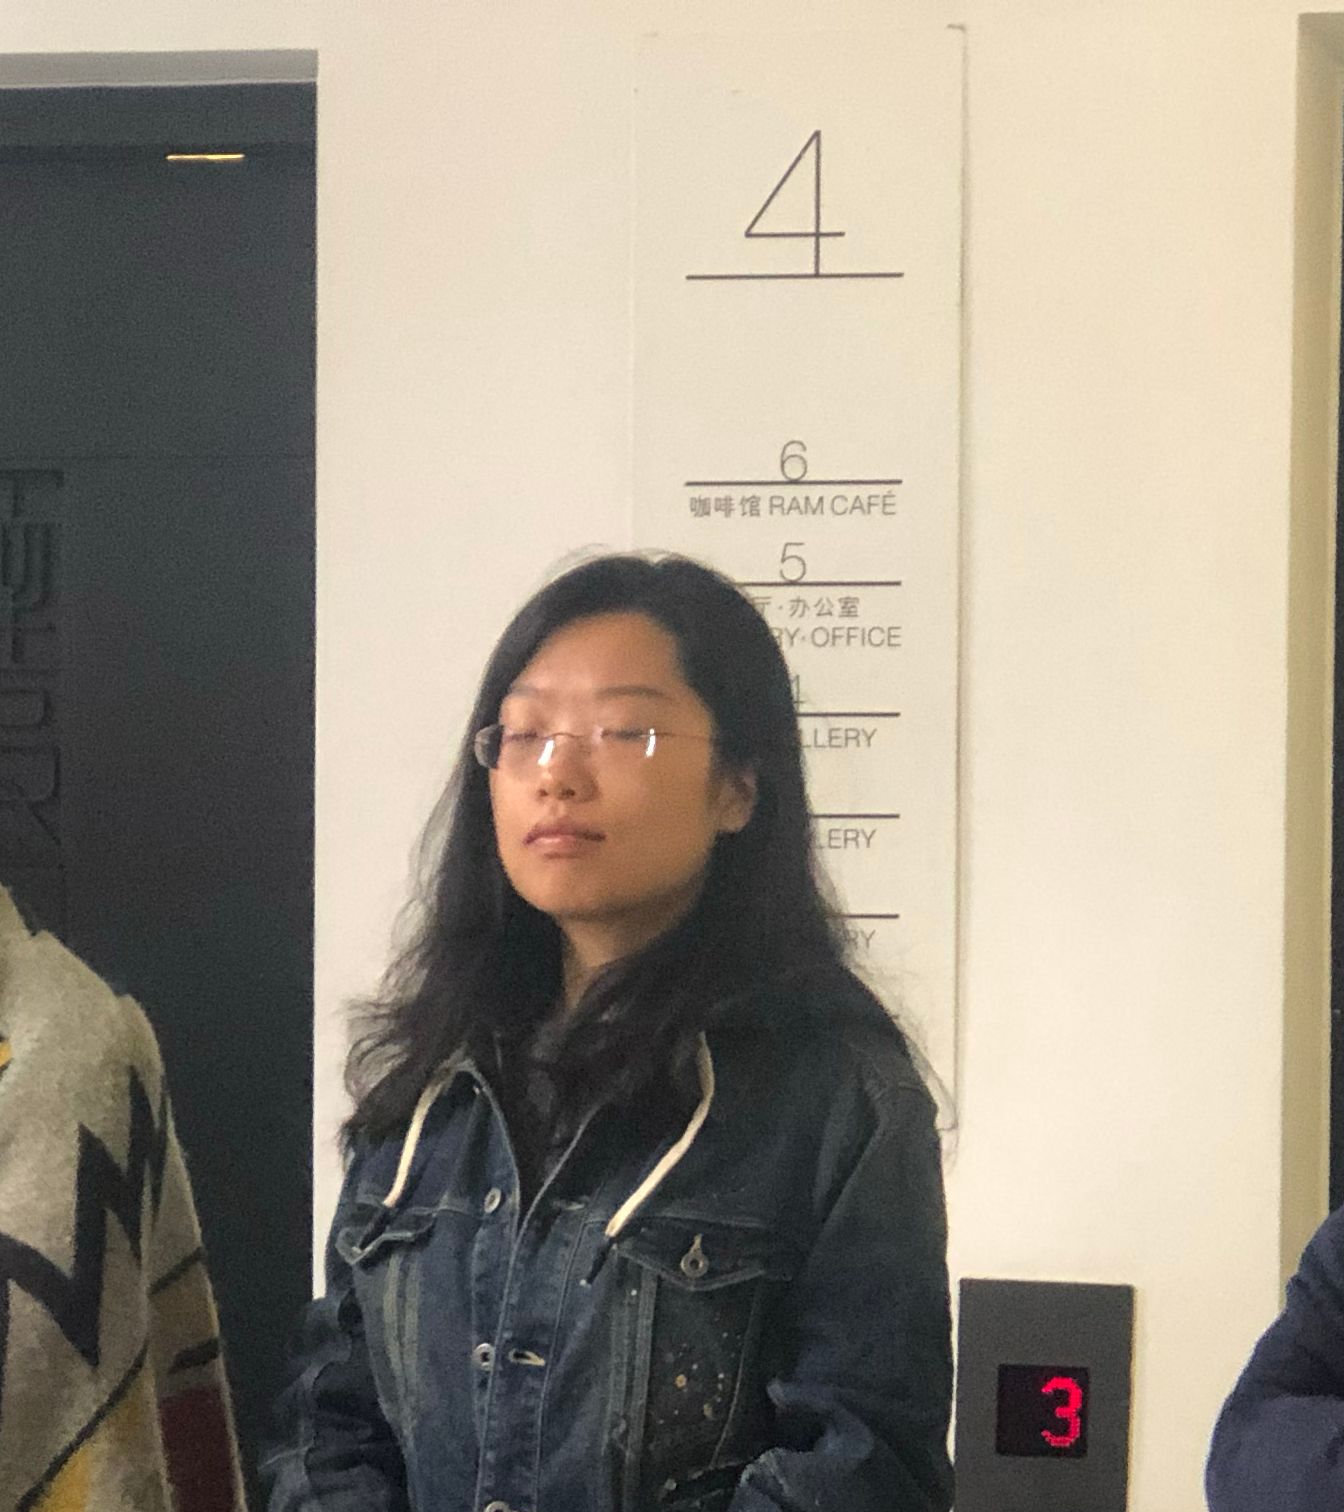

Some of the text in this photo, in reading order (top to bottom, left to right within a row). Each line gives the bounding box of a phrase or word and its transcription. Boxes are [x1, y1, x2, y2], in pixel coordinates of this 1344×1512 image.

[744, 129, 846, 277] 4
[779, 439, 808, 482] 6
[689, 490, 897, 518] 咖啡馆 RAM CAFÉ
[779, 541, 807, 582] 5
[1040, 1376, 1083, 1448] 3
